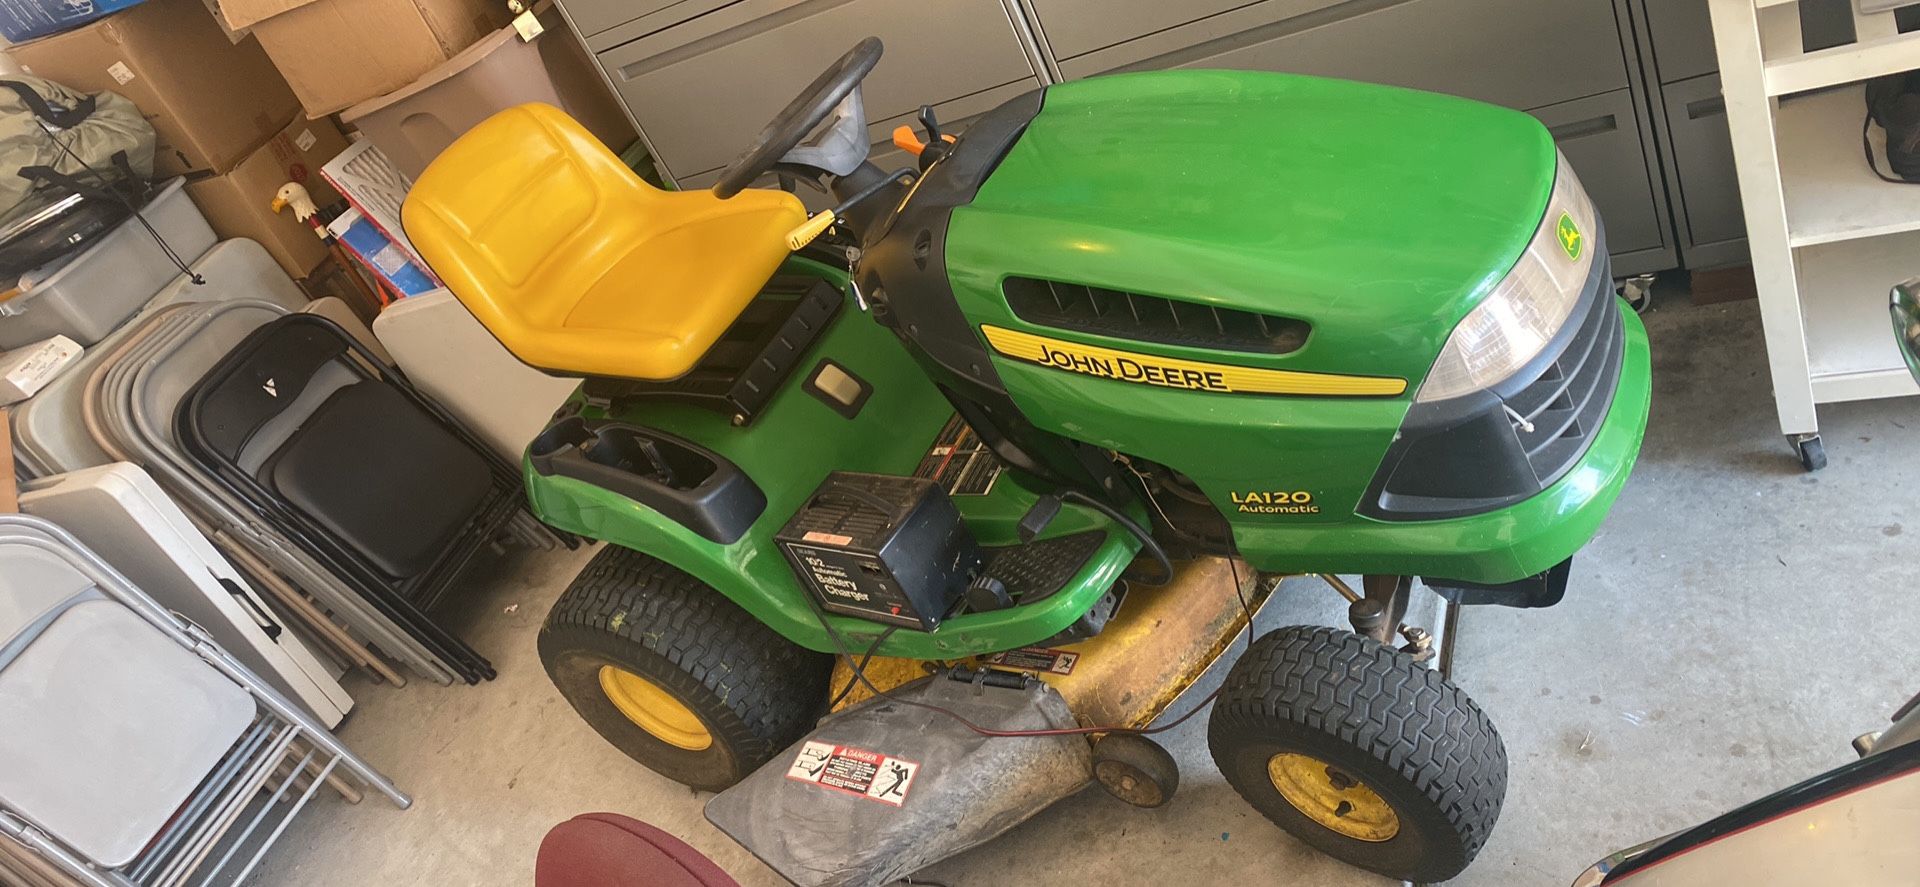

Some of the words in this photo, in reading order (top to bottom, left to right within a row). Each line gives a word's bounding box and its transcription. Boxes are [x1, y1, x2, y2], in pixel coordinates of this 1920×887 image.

[1037, 344, 1116, 377] JOHN
[1116, 357, 1230, 392] DEERE
[1231, 491, 1311, 503] LA120
[1238, 504, 1319, 513] Automatic
[814, 572, 858, 591] Battery
[824, 584, 870, 602] Charger
[847, 749, 878, 761] DANGER
